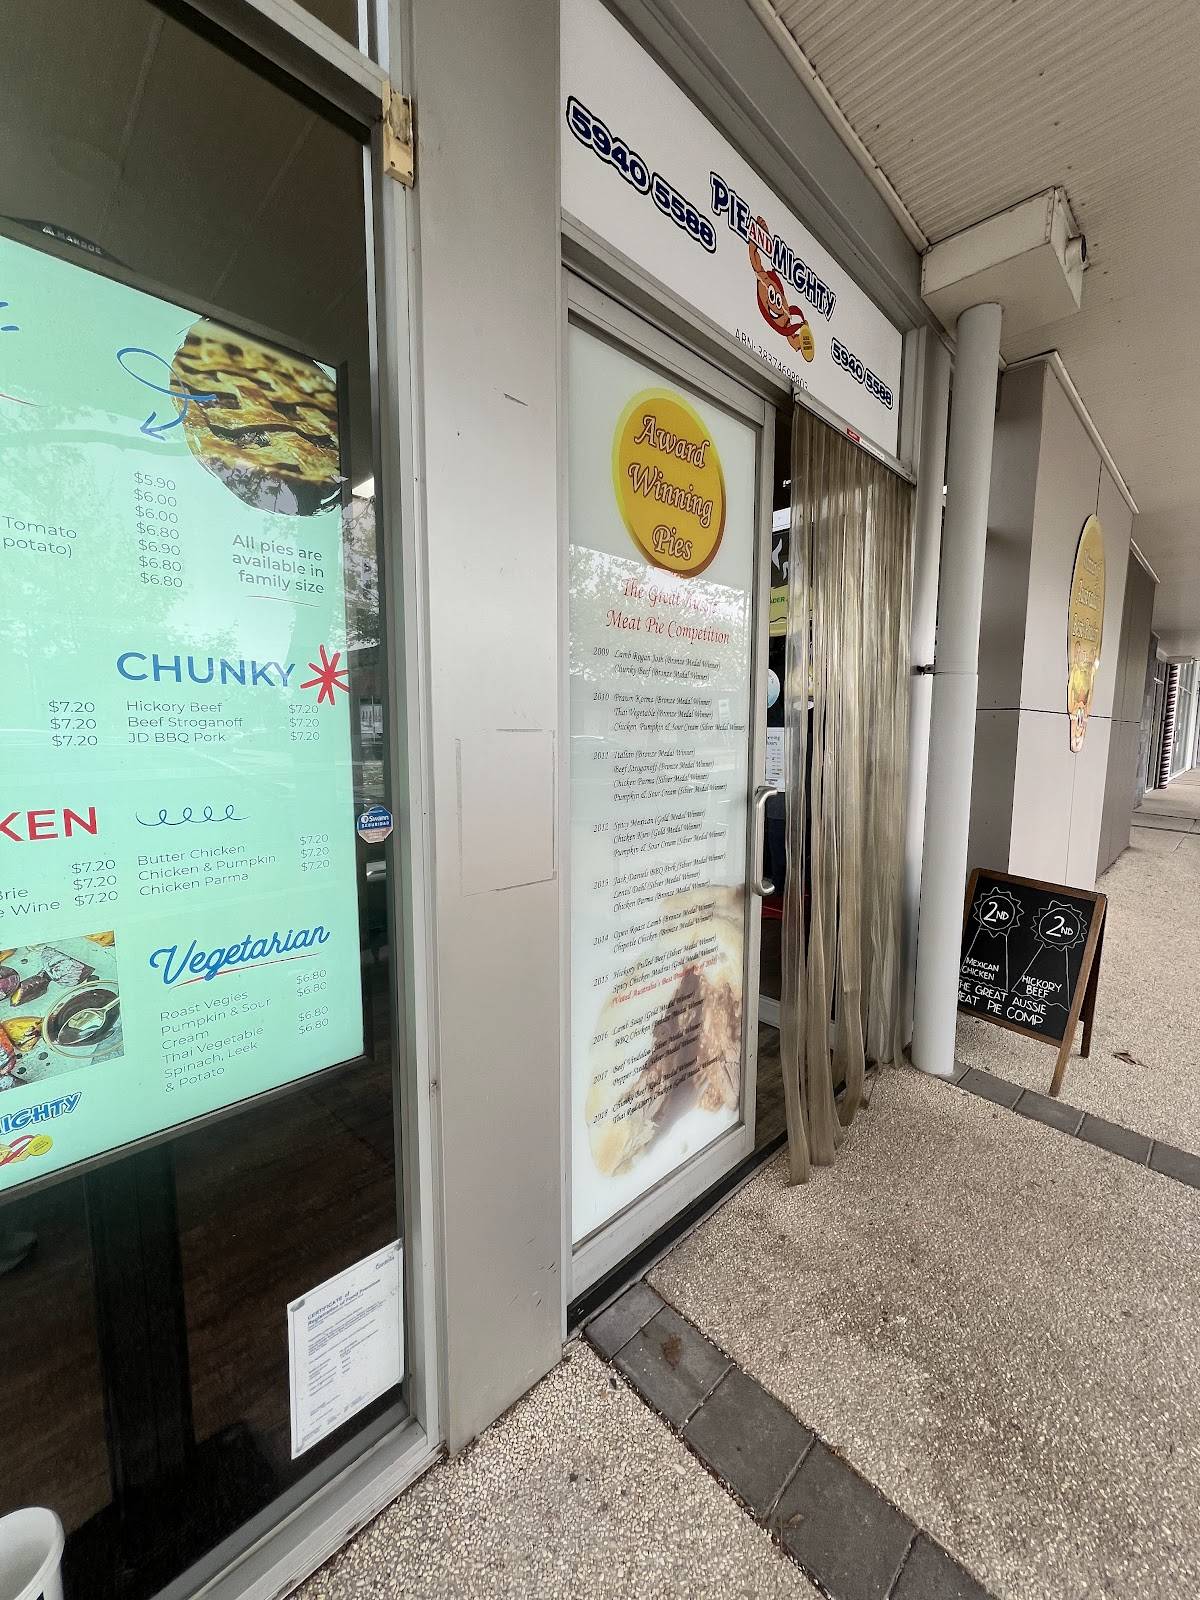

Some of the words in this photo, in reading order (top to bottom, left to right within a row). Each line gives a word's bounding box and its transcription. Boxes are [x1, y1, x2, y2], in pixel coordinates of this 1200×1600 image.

[568, 98, 648, 191] 5940
[653, 175, 715, 250] 5588
[711, 173, 750, 241] PIE
[750, 220, 773, 256] AND
[773, 237, 835, 320] MIGHTY
[832, 339, 865, 382] 5940
[866, 370, 893, 408] 5588
[634, 415, 710, 469] Award
[134, 471, 176, 490] $5.90
[134, 488, 177, 507] $6.00
[628, 463, 714, 528] Winning
[136, 505, 178, 523] $6.00
[1, 515, 77, 539] Tomato
[136, 521, 179, 539] $6.80
[3, 536, 72, 559] potato)
[139, 538, 181, 556] $6.90
[232, 534, 255, 549] All
[260, 540, 294, 556] pies
[298, 549, 323, 561] are
[651, 525, 693, 561] Pies
[139, 555, 182, 572] $6.80
[232, 554, 306, 574] available
[310, 563, 324, 578] in
[140, 571, 183, 587] $6.80
[238, 569, 291, 591] family
[295, 579, 325, 593] size
[622, 578, 642, 599] The
[649, 585, 681, 607] Great
[605, 610, 642, 631] Meat
[646, 617, 665, 634] Pie
[668, 621, 730, 645] Competition
[593, 647, 610, 656] 2009
[614, 650, 632, 659] Lamb
[685, 658, 702, 667] Medal
[116, 652, 296, 687] CHUNKY
[614, 664, 636, 677] Chunky
[638, 667, 651, 677] Beef
[673, 670, 691, 679] Medal
[48, 699, 96, 714] $7.20
[126, 700, 185, 714] Hickory
[190, 702, 223, 713] Beef
[288, 704, 319, 714] $7.20
[593, 692, 610, 701] 2010
[50, 716, 97, 731] $7.20
[128, 716, 164, 727] Beef
[168, 717, 243, 730] Stroganoff
[289, 717, 320, 728] $7.20
[614, 707, 628, 717] Thai
[630, 708, 656, 719] Vegetable
[51, 733, 99, 748] $7.20
[128, 732, 150, 743] JD
[155, 732, 190, 744] BBQ
[194, 732, 227, 742] Pork
[290, 731, 320, 742] $7.20
[613, 778, 636, 788] Chicken
[0, 806, 99, 842] KEN
[369, 815, 390, 823] Swann
[593, 822, 609, 833] 2012
[137, 852, 186, 866] Butter
[190, 845, 245, 859] Chicken
[300, 834, 329, 846] $7.20
[71, 859, 116, 874] $7.20
[138, 866, 199, 881] Chicken
[203, 862, 213, 872] &
[216, 855, 276, 870] Pumpkin
[300, 846, 330, 859] $7.20
[73, 875, 117, 891] $7.20
[139, 880, 200, 896] Chicken
[205, 873, 249, 886] Parma
[301, 859, 330, 872] $7.20
[10, 901, 60, 916] Wine
[74, 890, 118, 907] $7.20
[983, 902, 1009, 922] 2ND
[1046, 916, 1073, 937] 2ND
[150, 925, 330, 984] Vegetarian
[965, 957, 1000, 972] MEXICAN
[961, 966, 995, 981] CHICKEN
[1022, 975, 1062, 992] HICKORY
[160, 1003, 201, 1021] Roast
[203, 991, 248, 1009] Vegies
[296, 969, 327, 985] $6.80
[959, 979, 971, 992] HE
[975, 985, 1009, 1002] GREAT
[1012, 996, 1047, 1015] AUSSIE
[1026, 986, 1050, 998] BEEF
[161, 1011, 226, 1036] Pumpkin
[230, 1006, 239, 1016] &
[242, 998, 271, 1012] Sour
[296, 981, 327, 997] $6.80
[987, 1000, 1002, 1015] PIE
[1007, 1007, 1044, 1025] COMP
[162, 1047, 193, 1063] Thai
[196, 1027, 264, 1053] Vegetable
[298, 1005, 328, 1021] $6.80
[162, 1030, 209, 1050] Cream
[164, 1053, 224, 1078] Spinach,
[228, 1041, 258, 1058] Leek
[299, 1018, 328, 1035] $6.80
[165, 1082, 174, 1093] &
[179, 1067, 225, 1087] Potato
[0, 1092, 81, 1134] IGHTY
